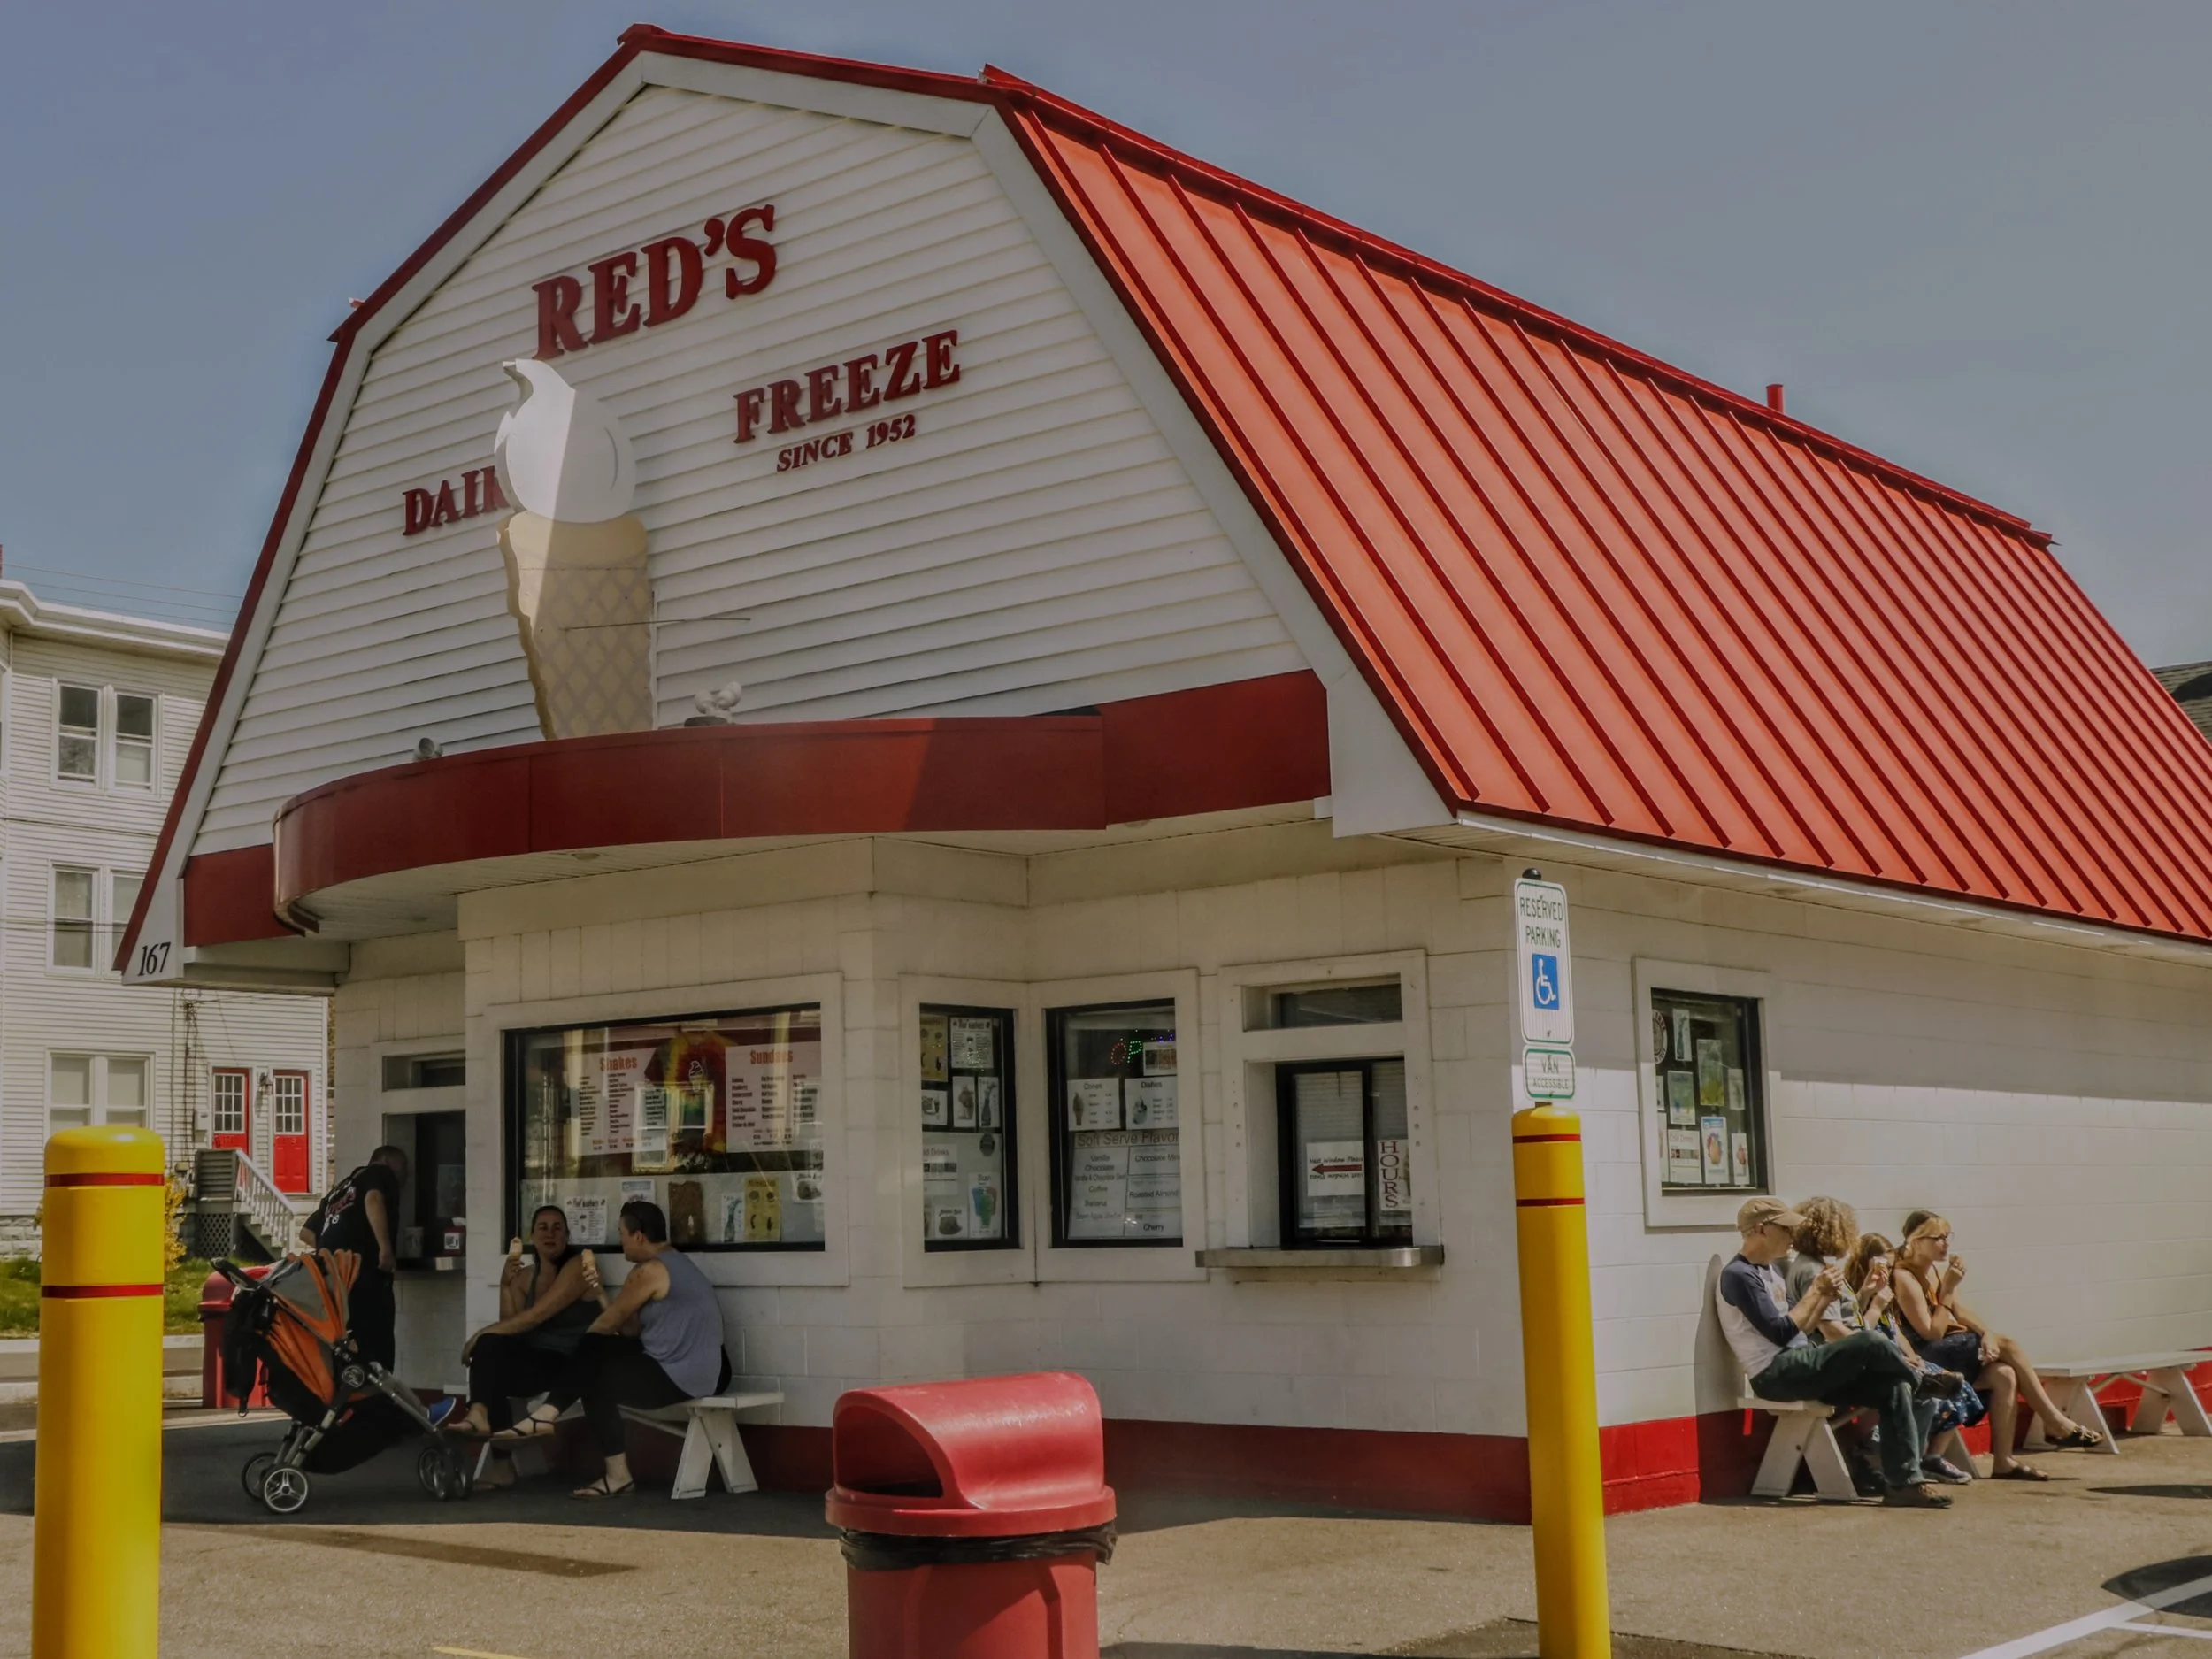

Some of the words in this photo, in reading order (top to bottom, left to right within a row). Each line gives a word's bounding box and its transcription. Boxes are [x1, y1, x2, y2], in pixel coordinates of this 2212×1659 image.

[533, 204, 777, 359] RED'S
[403, 465, 511, 536] DAIR
[733, 329, 961, 443] FREEZE
[776, 431, 854, 472] SINCE
[865, 413, 916, 449] 1952
[1519, 897, 1563, 921] RESERVED
[1525, 926, 1561, 949] PARKING
[137, 941, 171, 977] 167
[1540, 1058, 1559, 1074] VAN
[1077, 1133, 1100, 1147] Soft
[1103, 1133, 1138, 1145] Serve
[1141, 1131, 1179, 1144] Flavor
[1379, 1141, 1400, 1208] HOURS
[1143, 1223, 1164, 1233] Cherry
